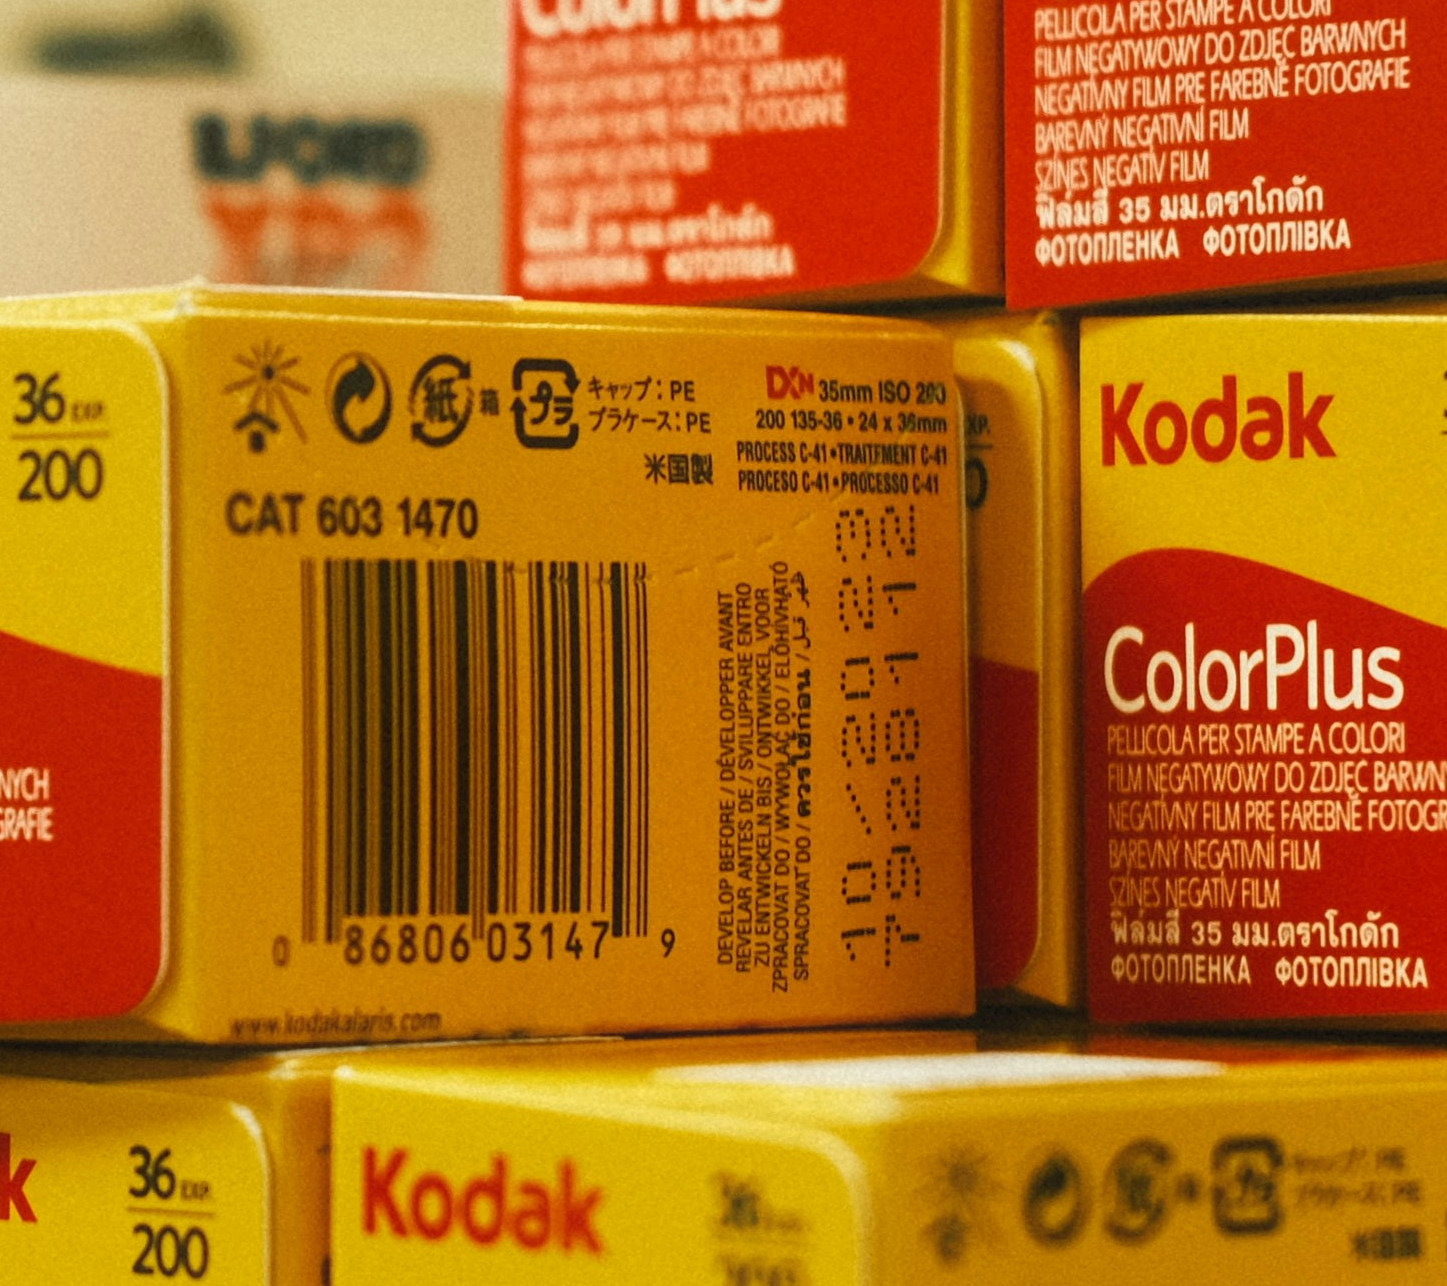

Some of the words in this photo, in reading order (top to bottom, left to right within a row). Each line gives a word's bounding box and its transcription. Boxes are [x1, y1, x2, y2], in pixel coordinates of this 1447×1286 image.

[13, 372, 66, 425] 36
[756, 408, 786, 430] 200
[792, 408, 843, 431] 135-36
[858, 411, 879, 432] 24
[818, 380, 873, 403] 35mm
[878, 380, 910, 404] ISO
[1100, 371, 1336, 467] Kodak
[17, 447, 104, 502] 200
[736, 440, 796, 463] PROCESS
[738, 470, 798, 492] PROCESO
[912, 472, 939, 495] C-41
[224, 491, 305, 537] CAT
[317, 494, 383, 538] 603
[397, 496, 479, 539] 1470
[718, 591, 733, 652] AVANT
[736, 583, 752, 646] ENTRO
[755, 588, 770, 641] VOOR
[1104, 619, 1405, 713] ColorPlus
[716, 658, 735, 782] DÉVELOPPER
[737, 652, 753, 770] SVILUPPARE
[755, 647, 771, 758] ONTWIKKEL
[836, 510, 876, 961] 10/2023
[738, 790, 753, 813] DE
[757, 777, 772, 807] BIS
[718, 800, 734, 872] BEFORE
[738, 820, 753, 881] ANTES
[755, 814, 771, 935] ENTWICKELN
[272, 935, 291, 967] 0
[344, 923, 471, 965] 86806
[486, 920, 610, 963] 03147
[660, 928, 676, 959] 9
[717, 880, 734, 964] DEVELOP
[736, 887, 752, 972] REVELAR
[755, 943, 770, 967] ZU
[127, 1145, 177, 1200] 36
[362, 1144, 606, 1256] Kodak
[131, 1223, 209, 1279] 200
